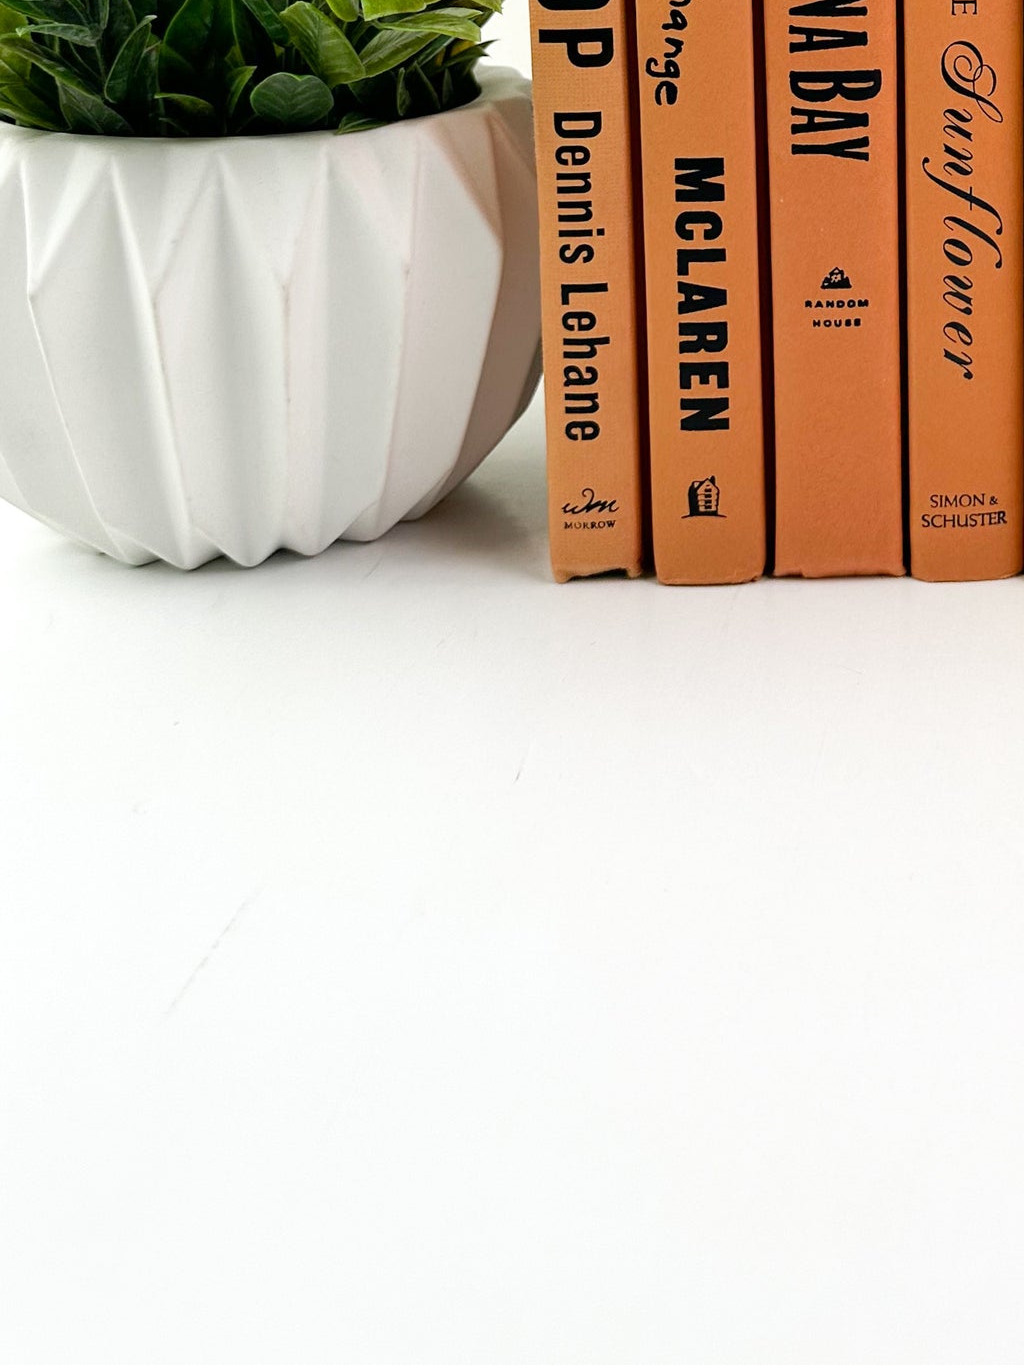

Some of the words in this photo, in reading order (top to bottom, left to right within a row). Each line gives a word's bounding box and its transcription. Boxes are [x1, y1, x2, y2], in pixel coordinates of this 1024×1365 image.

[788, 68, 883, 162] BAY
[553, 110, 606, 265] Dennis
[921, 40, 1004, 380] Sunflower
[674, 157, 730, 432] MCLAREN
[804, 298, 869, 309] RANDOM
[812, 317, 861, 328] HOUSE
[560, 282, 611, 442] Lehane
[564, 519, 616, 530] MORROW
[921, 510, 1008, 528] SCHUSTER
[930, 493, 985, 508] SIMON
[989, 495, 998, 506] &
